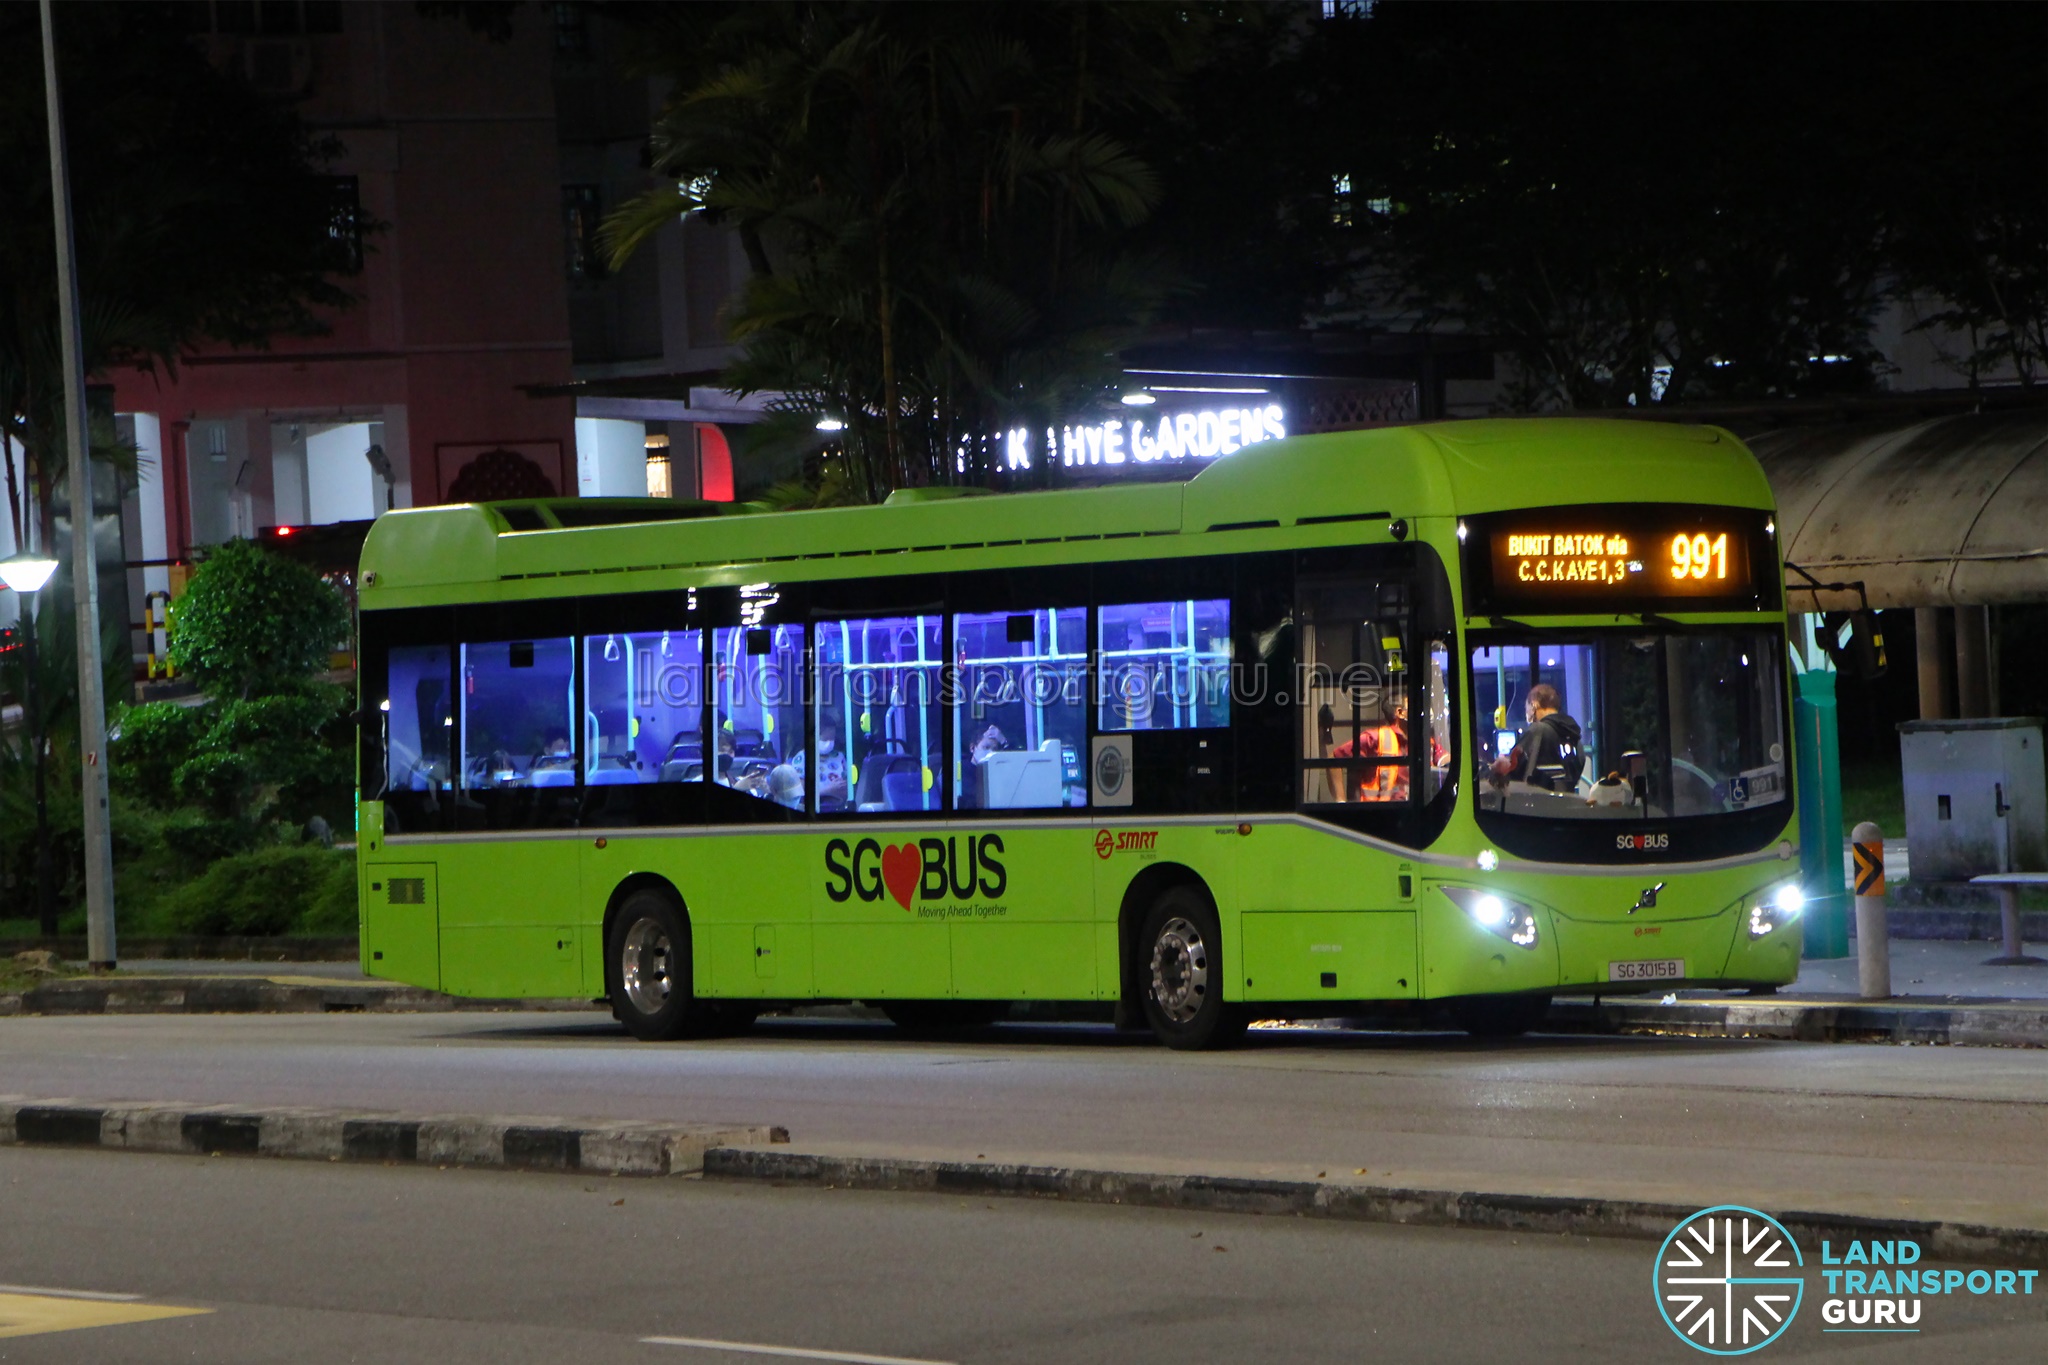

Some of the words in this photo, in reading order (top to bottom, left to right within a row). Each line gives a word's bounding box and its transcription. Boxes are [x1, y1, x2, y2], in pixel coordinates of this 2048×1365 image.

[1131, 404, 1286, 463] GARDENS
[1508, 535, 1551, 556] BUKIT
[1553, 534, 1604, 555] BATOK
[1670, 532, 1728, 580] 991
[1752, 775, 1774, 794] 991
[1115, 831, 1159, 850] SMRT
[917, 905, 946, 921] Moving
[947, 904, 972, 918] Ahead
[974, 903, 1008, 919] Together
